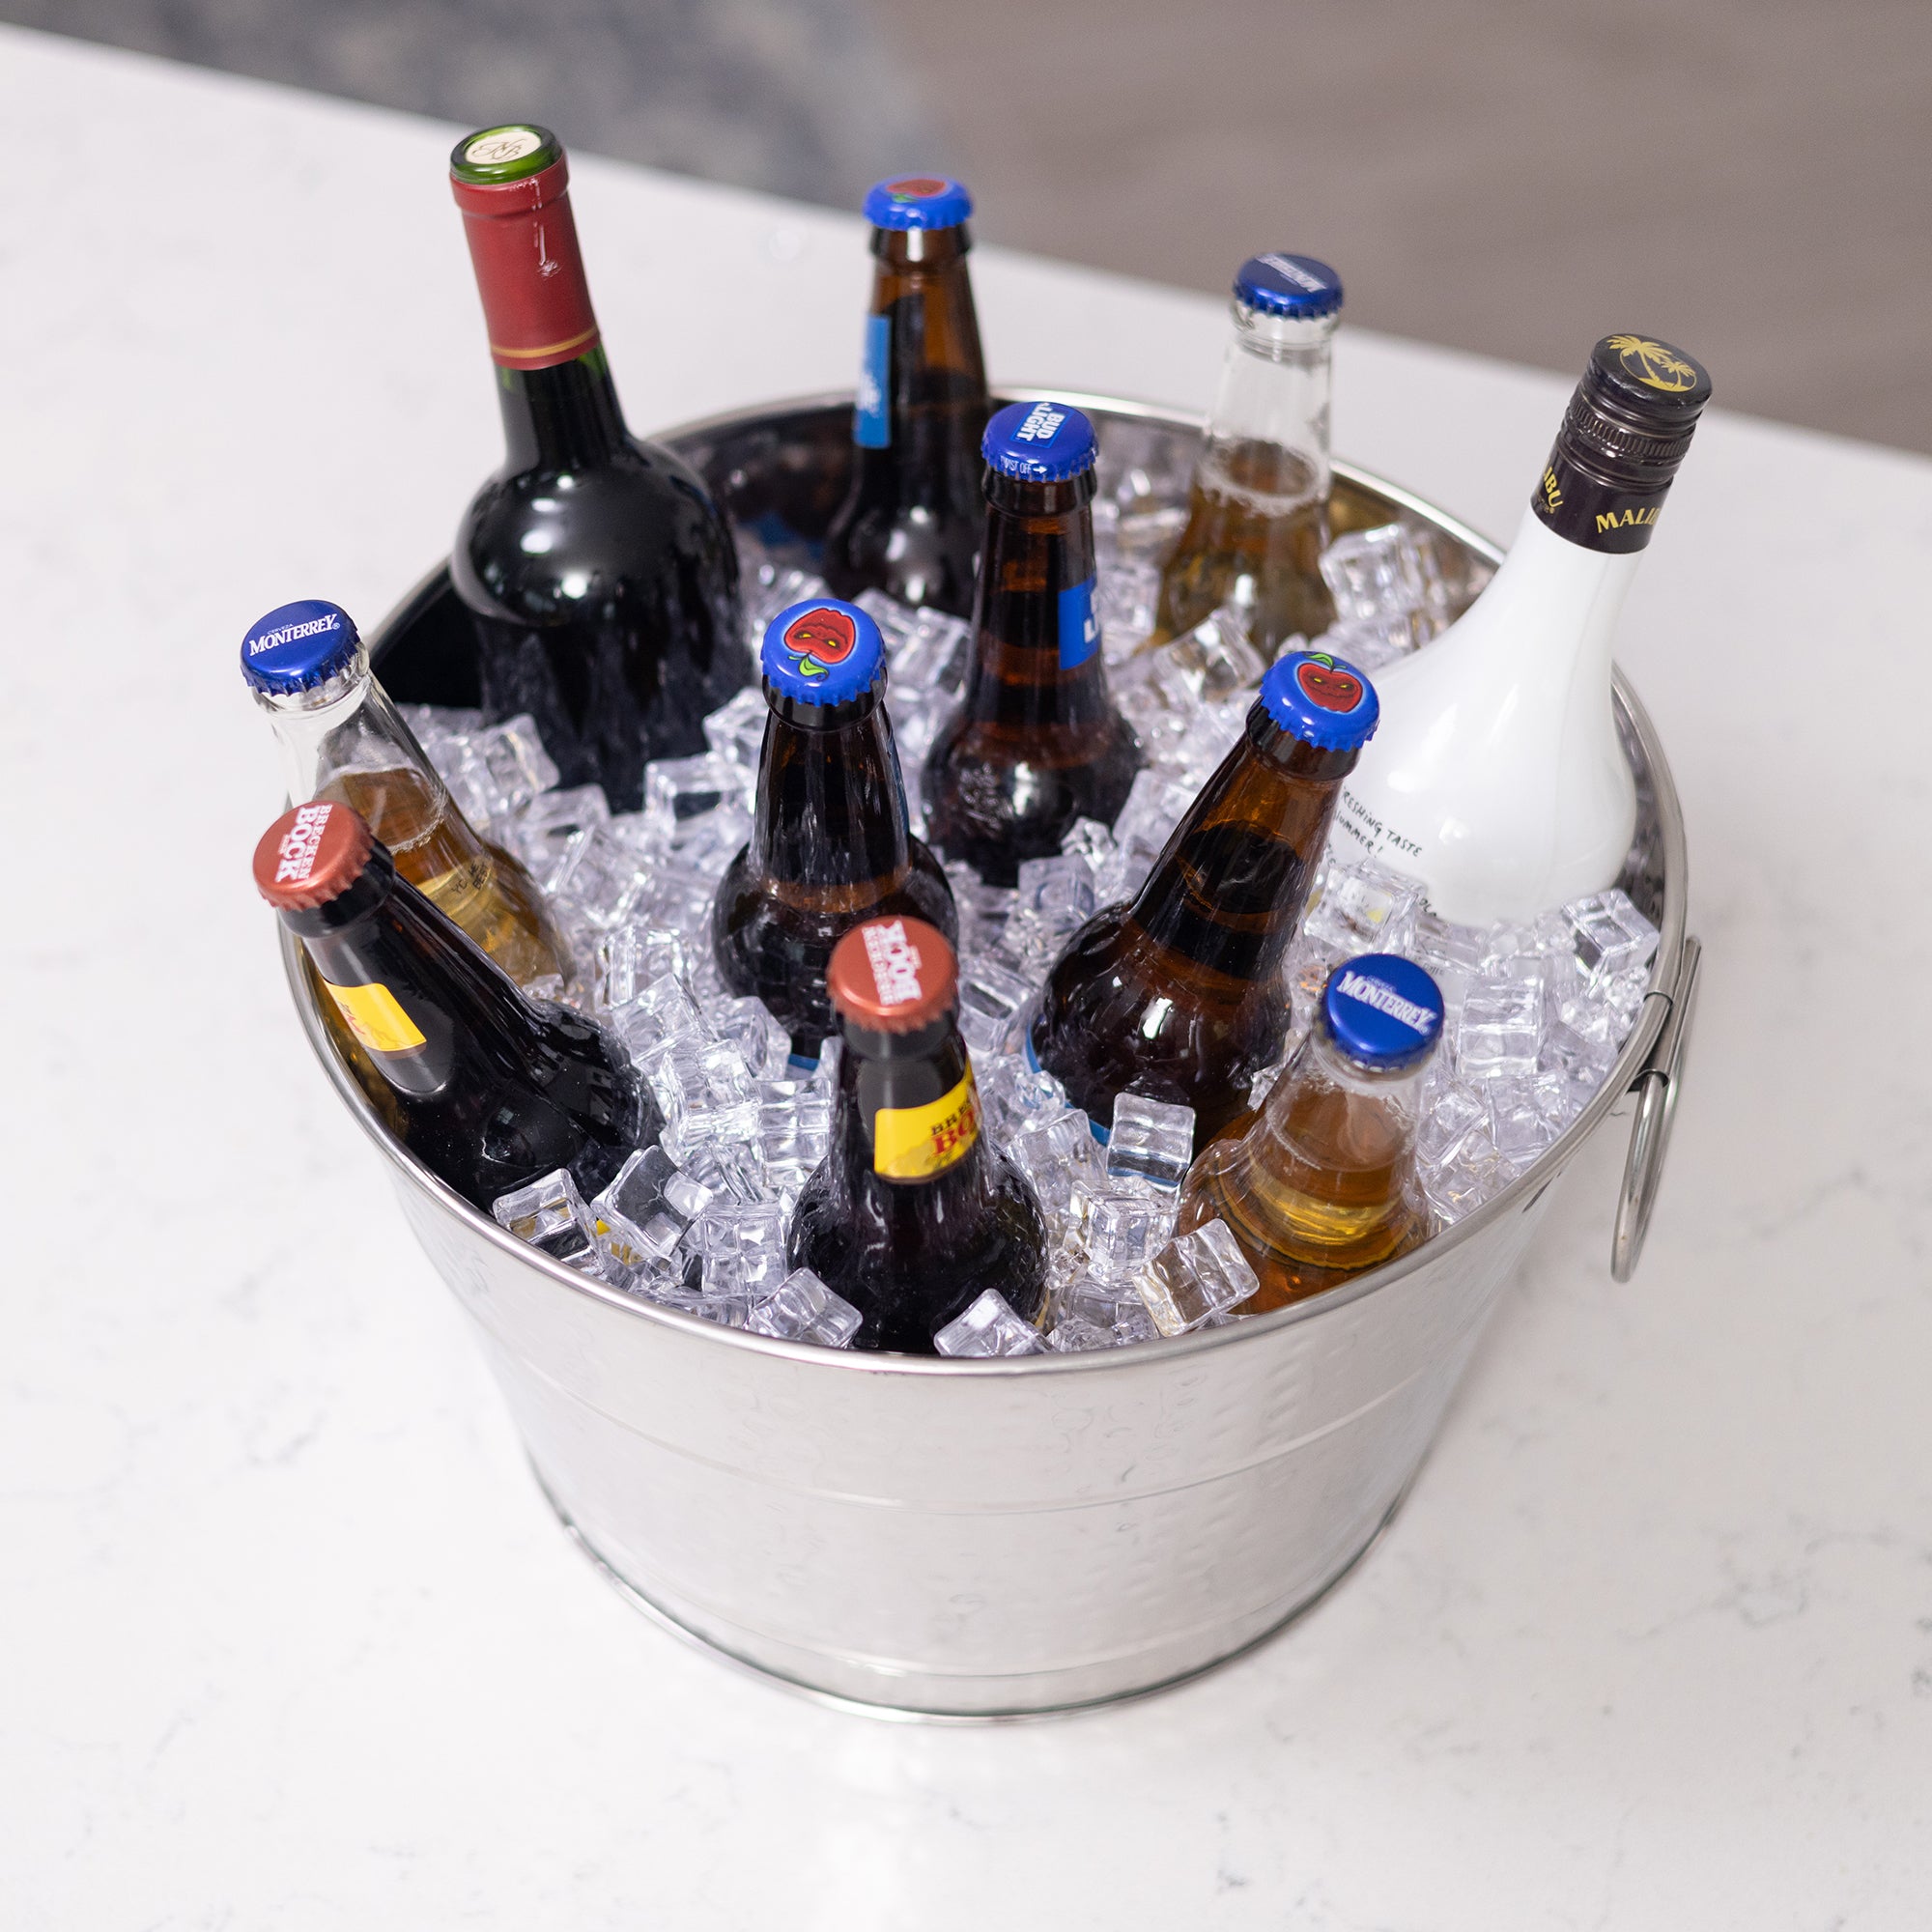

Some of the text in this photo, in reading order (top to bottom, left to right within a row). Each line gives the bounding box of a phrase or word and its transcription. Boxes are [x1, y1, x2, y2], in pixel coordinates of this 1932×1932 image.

[1016, 402, 1053, 441] LIGHT
[1037, 412, 1066, 440] BUD
[1595, 507, 1662, 534] MALIB
[248, 613, 338, 657] MONTERREY
[274, 806, 321, 884] BOCK
[1341, 789, 1423, 858] RESHING TASTE
[875, 919, 923, 1005] BOCK
[1336, 970, 1438, 1031] MONTERREY
